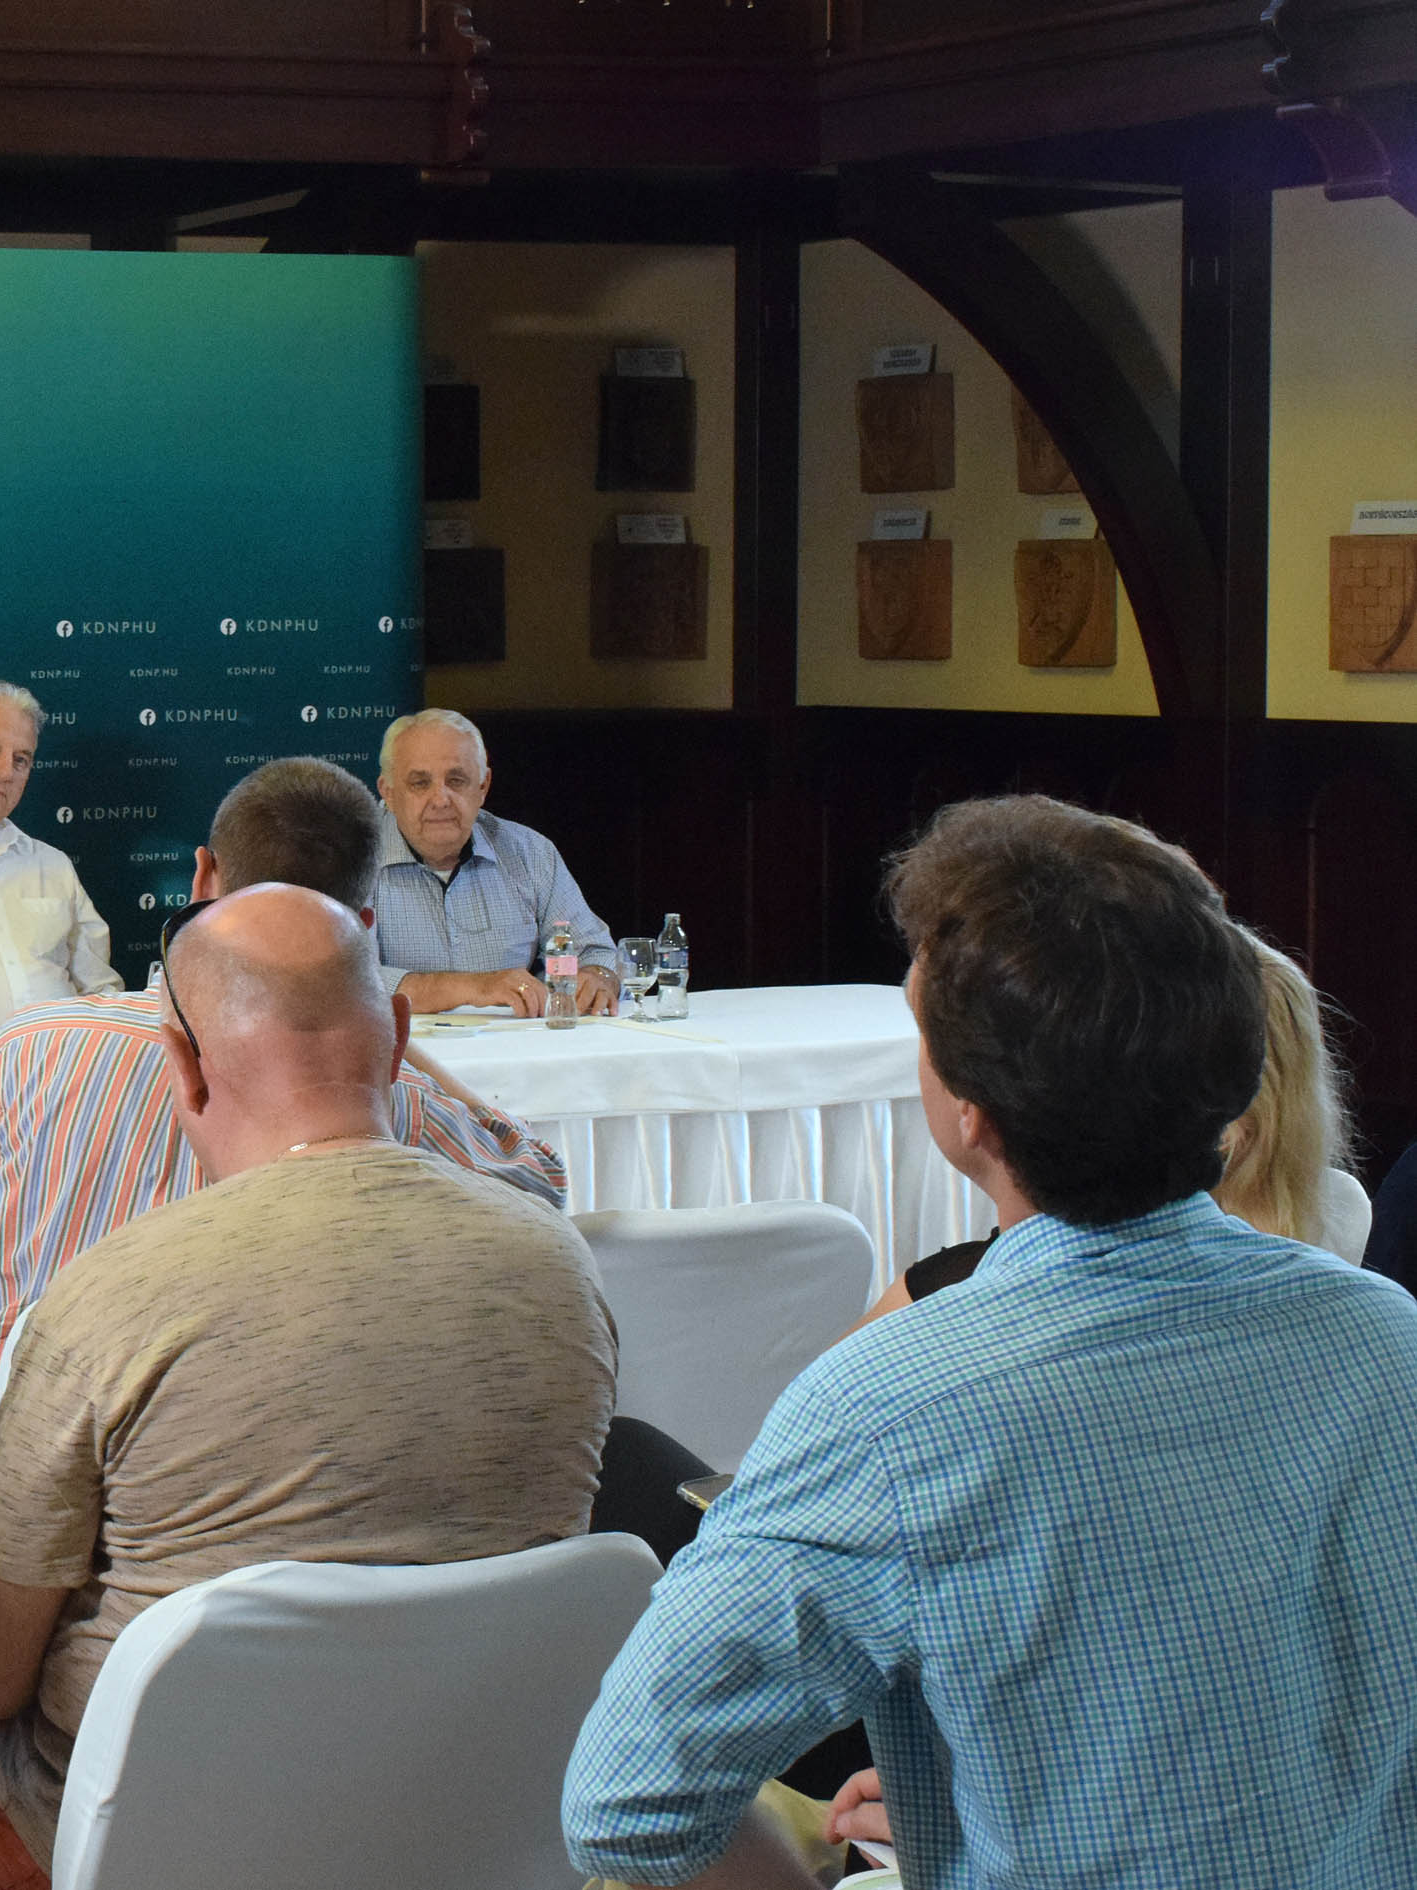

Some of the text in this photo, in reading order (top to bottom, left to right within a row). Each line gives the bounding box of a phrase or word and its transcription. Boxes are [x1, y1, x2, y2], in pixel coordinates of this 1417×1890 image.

[82, 620, 157, 635] KDNPHU
[245, 618, 319, 633] KDNPHU
[164, 708, 238, 723] KDNPHU
[327, 706, 396, 720] KDNPHU
[82, 805, 158, 820] KDNPHU
